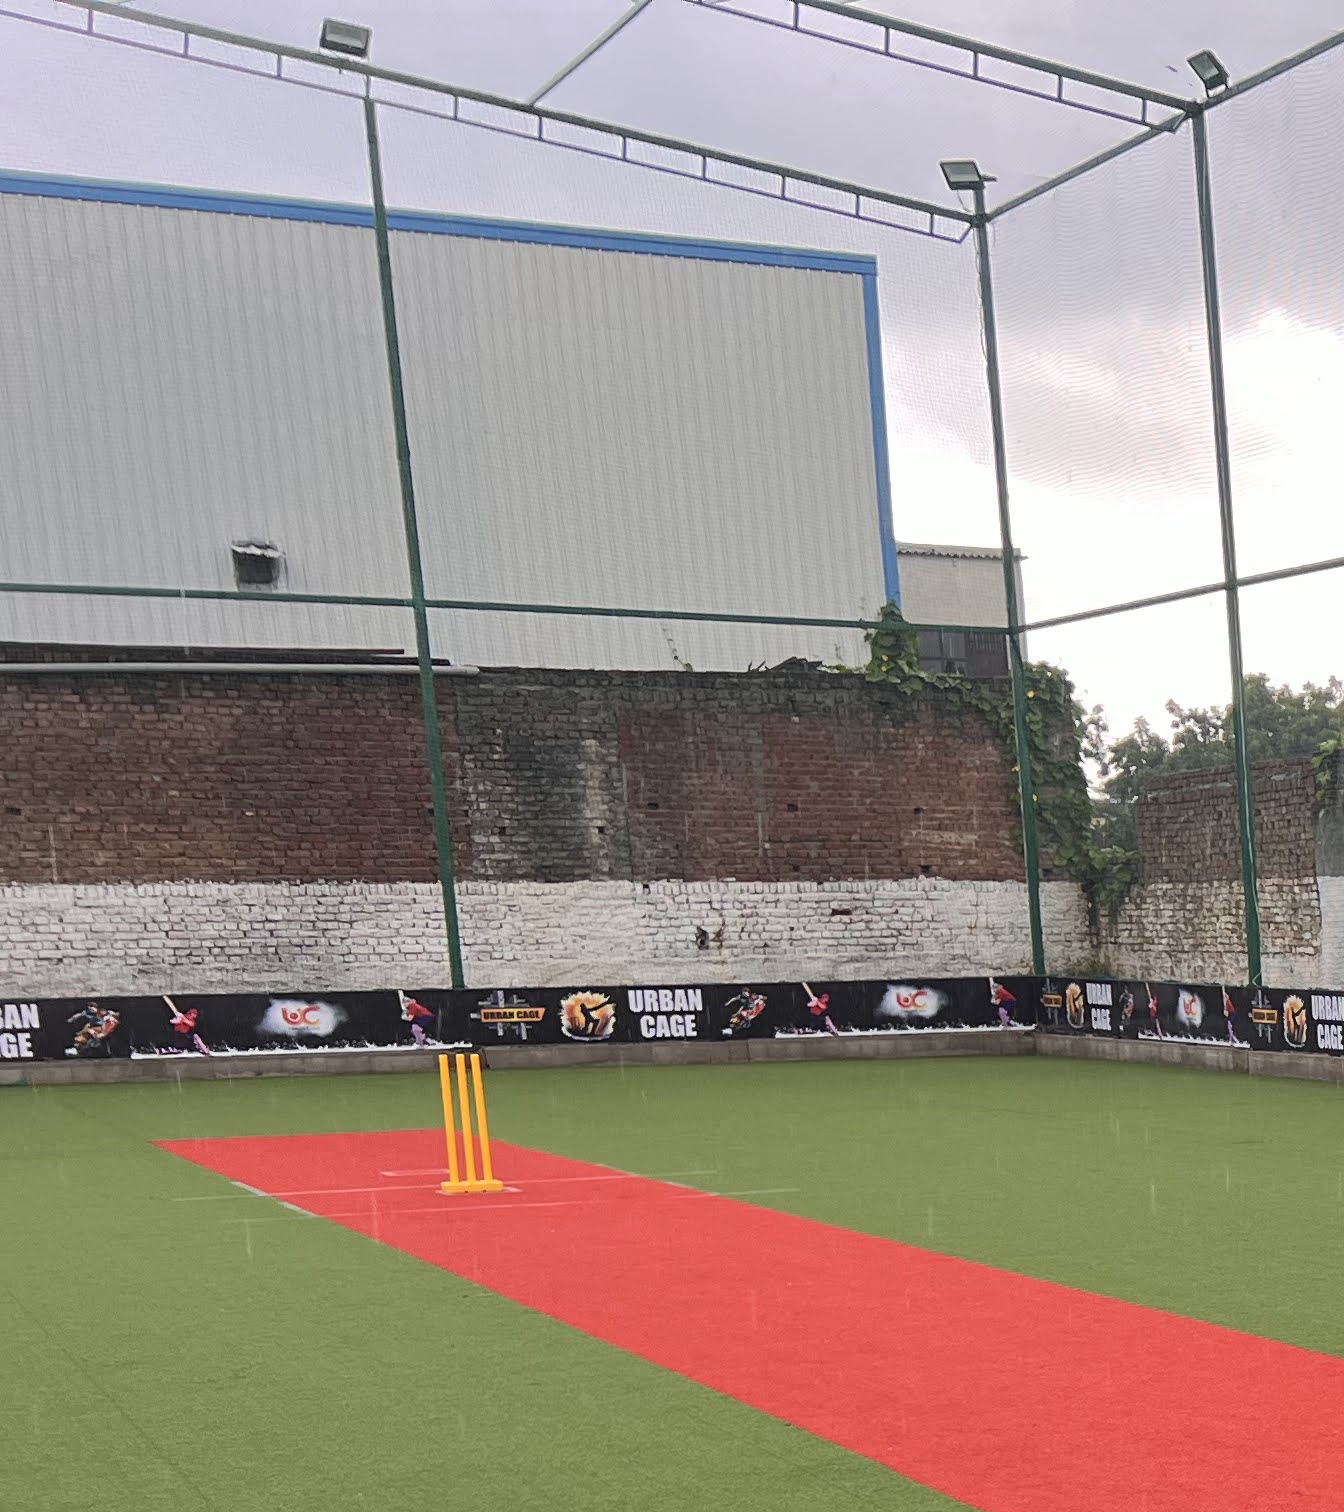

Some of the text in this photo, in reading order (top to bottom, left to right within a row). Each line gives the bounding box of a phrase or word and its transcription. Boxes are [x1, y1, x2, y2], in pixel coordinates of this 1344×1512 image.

[627, 989, 703, 1012] URBAN
[0, 1004, 40, 1029] AN
[640, 1014, 698, 1038] CAGE
[1317, 1024, 1344, 1050] CAGE
